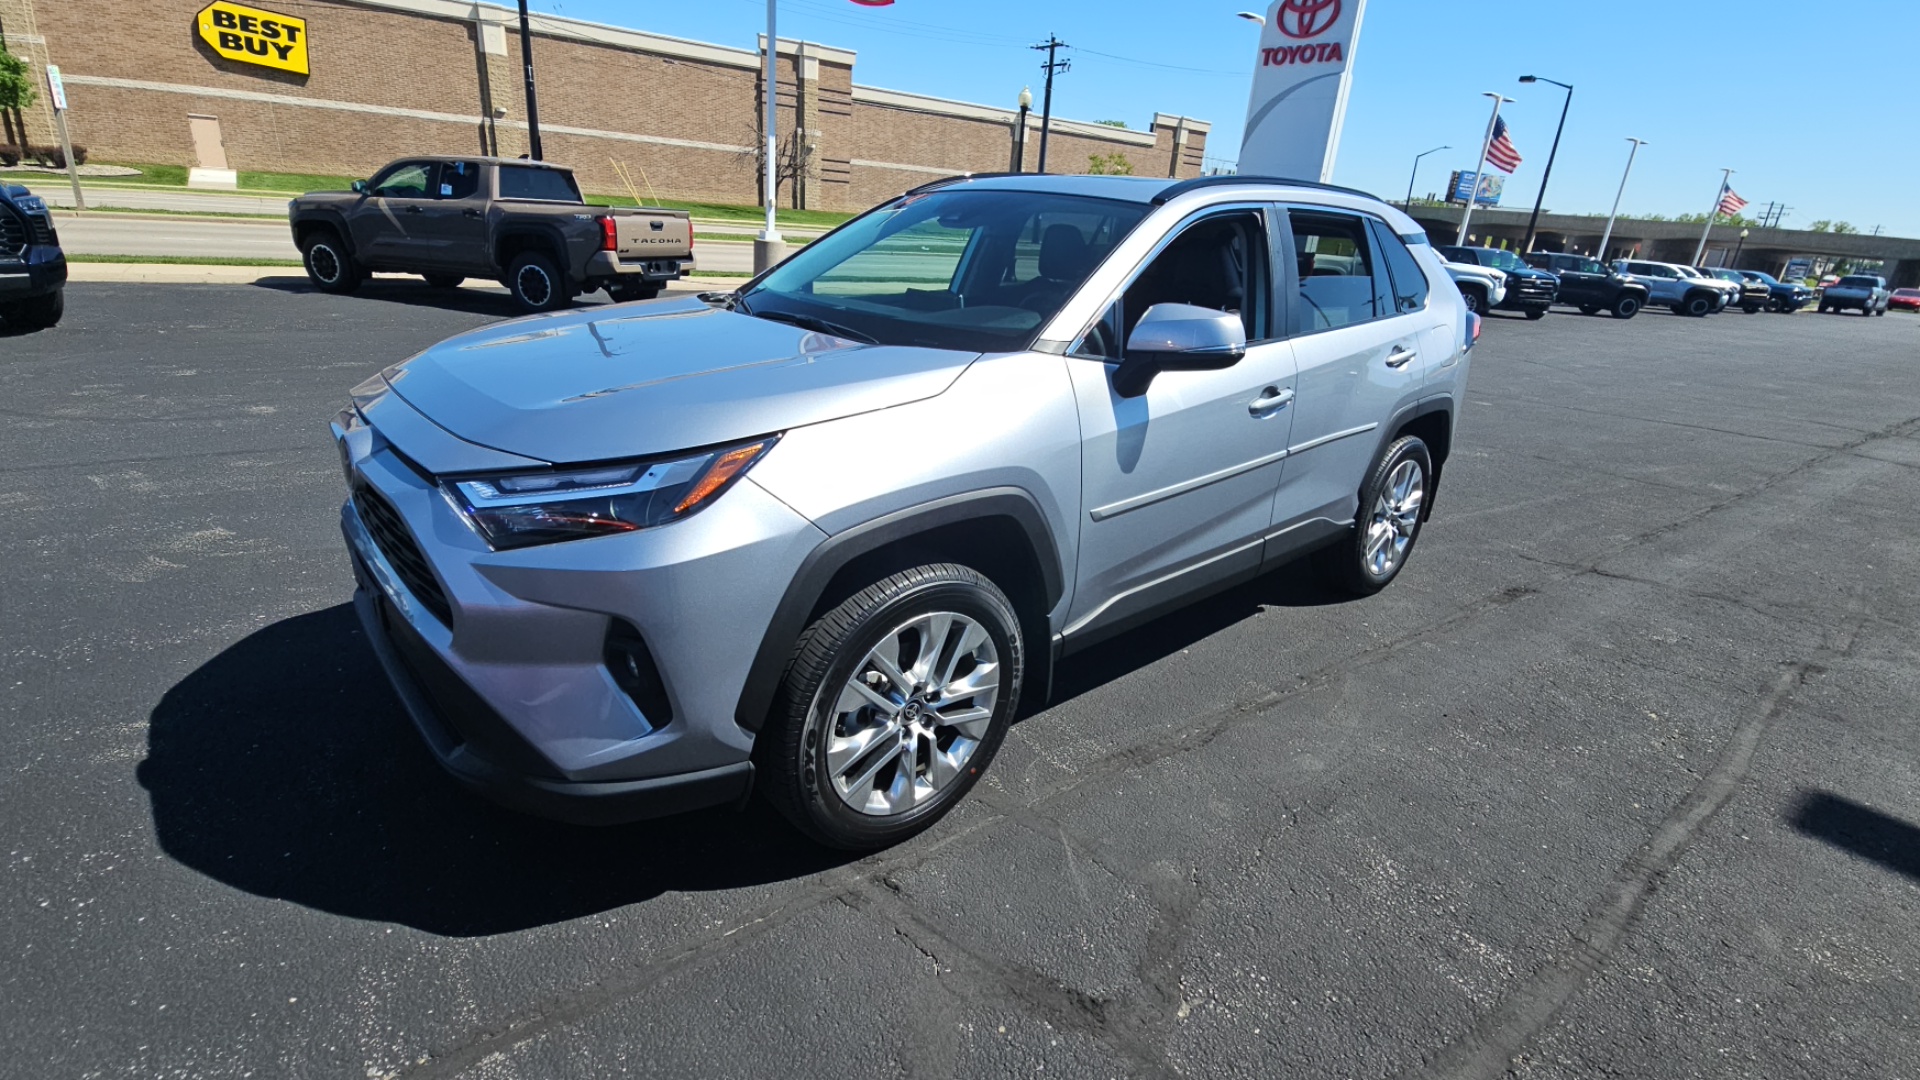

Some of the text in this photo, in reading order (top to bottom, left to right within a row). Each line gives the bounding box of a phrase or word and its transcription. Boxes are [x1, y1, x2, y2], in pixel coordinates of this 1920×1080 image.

[212, 9, 301, 43] BEST
[218, 31, 295, 61] BUY
[1262, 42, 1343, 67] TOYOTA
